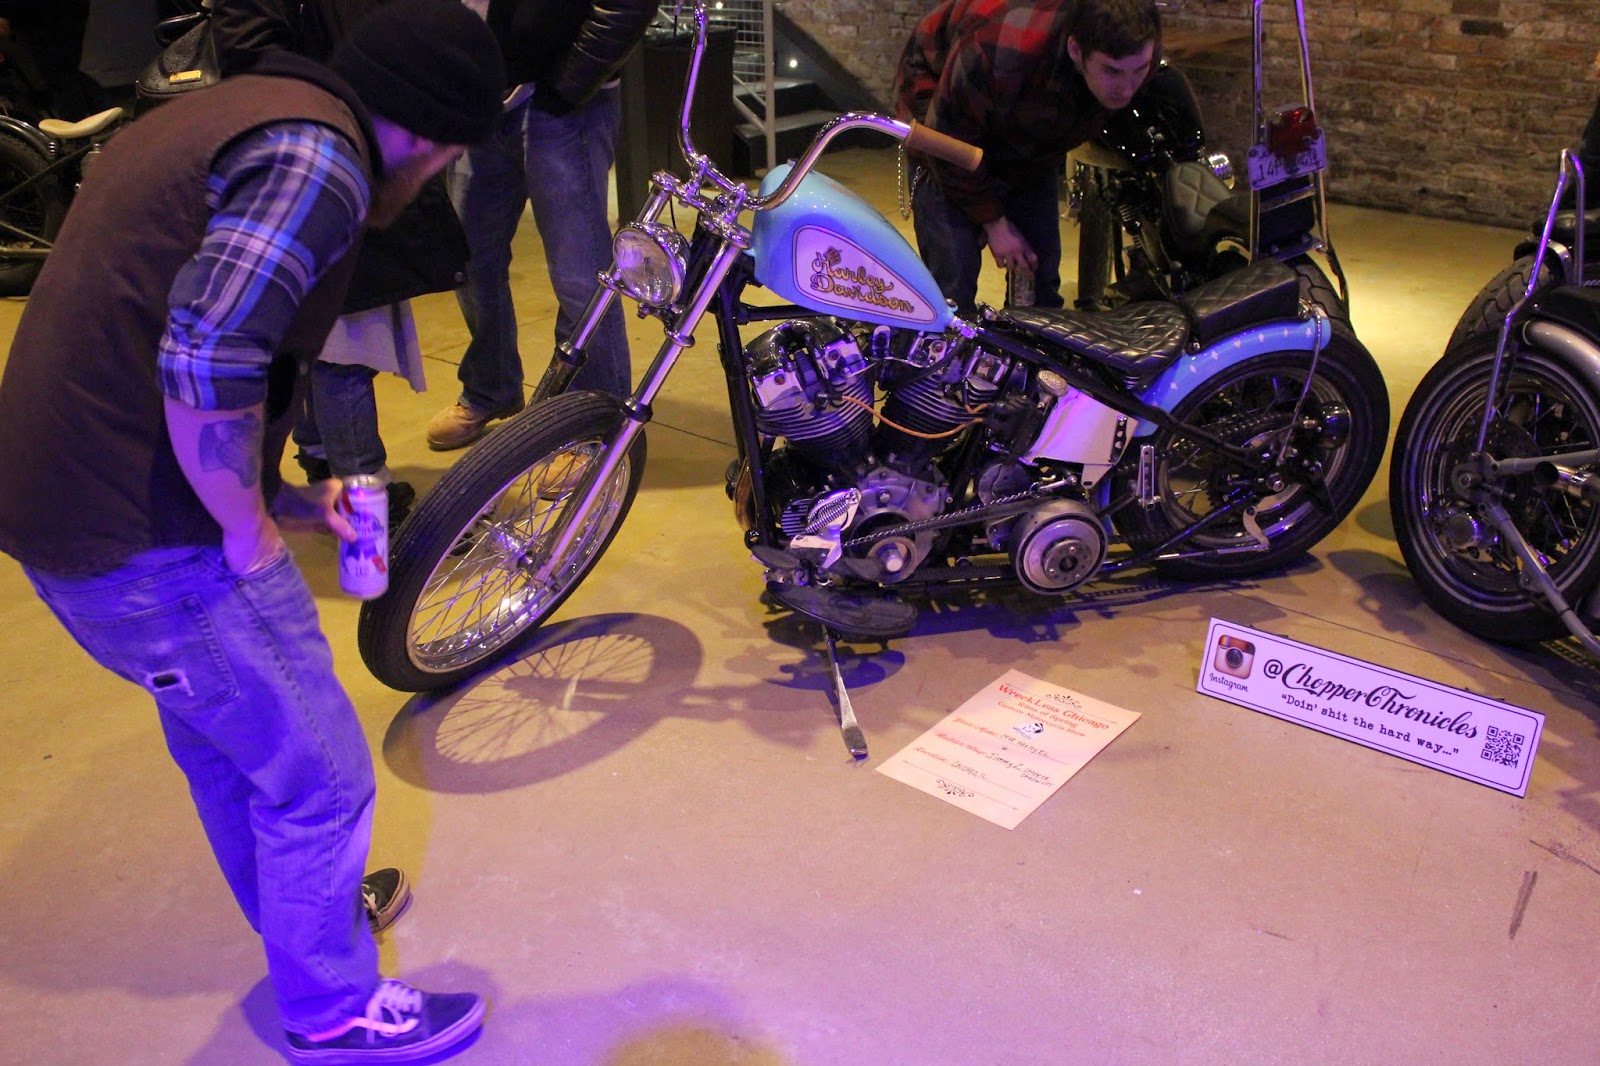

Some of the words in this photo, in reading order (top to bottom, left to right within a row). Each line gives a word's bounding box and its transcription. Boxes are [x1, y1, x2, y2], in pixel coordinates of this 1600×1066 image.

[811, 252, 894, 293] Harley
[810, 273, 914, 313] Davidson
[1209, 672, 1249, 692] Instagram
[1027, 710, 1065, 732] Motorcycle
[1065, 728, 1087, 738] Show
[1050, 713, 1078, 729] Spring
[1062, 710, 1109, 730] Chicago
[1321, 707, 1348, 722] shit
[1353, 717, 1374, 731] the
[1379, 724, 1411, 742] hard
